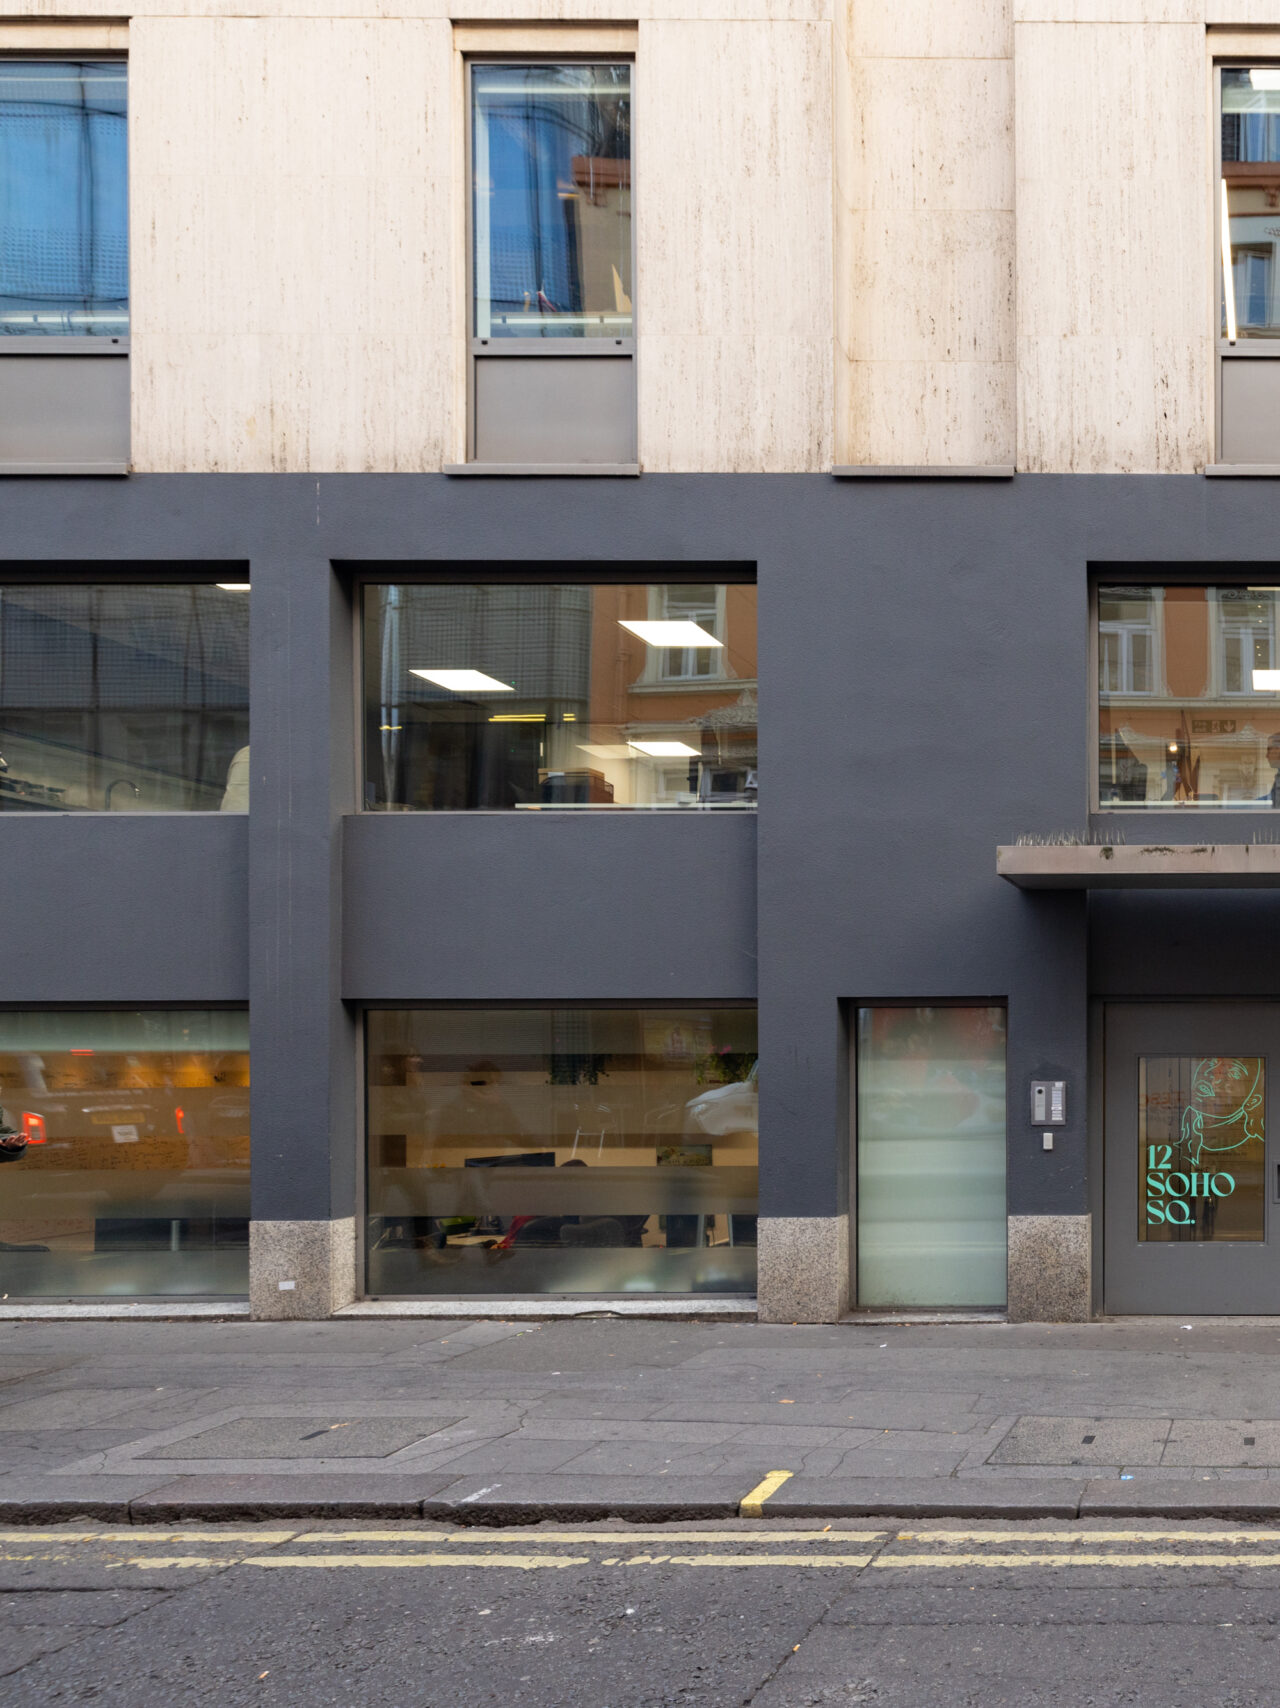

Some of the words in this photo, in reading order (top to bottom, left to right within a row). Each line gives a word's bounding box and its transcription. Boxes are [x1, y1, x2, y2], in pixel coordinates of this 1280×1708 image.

[1147, 1144, 1172, 1169] 12
[1147, 1172, 1235, 1197] SOHO
[1147, 1199, 1196, 1224] SQ.
